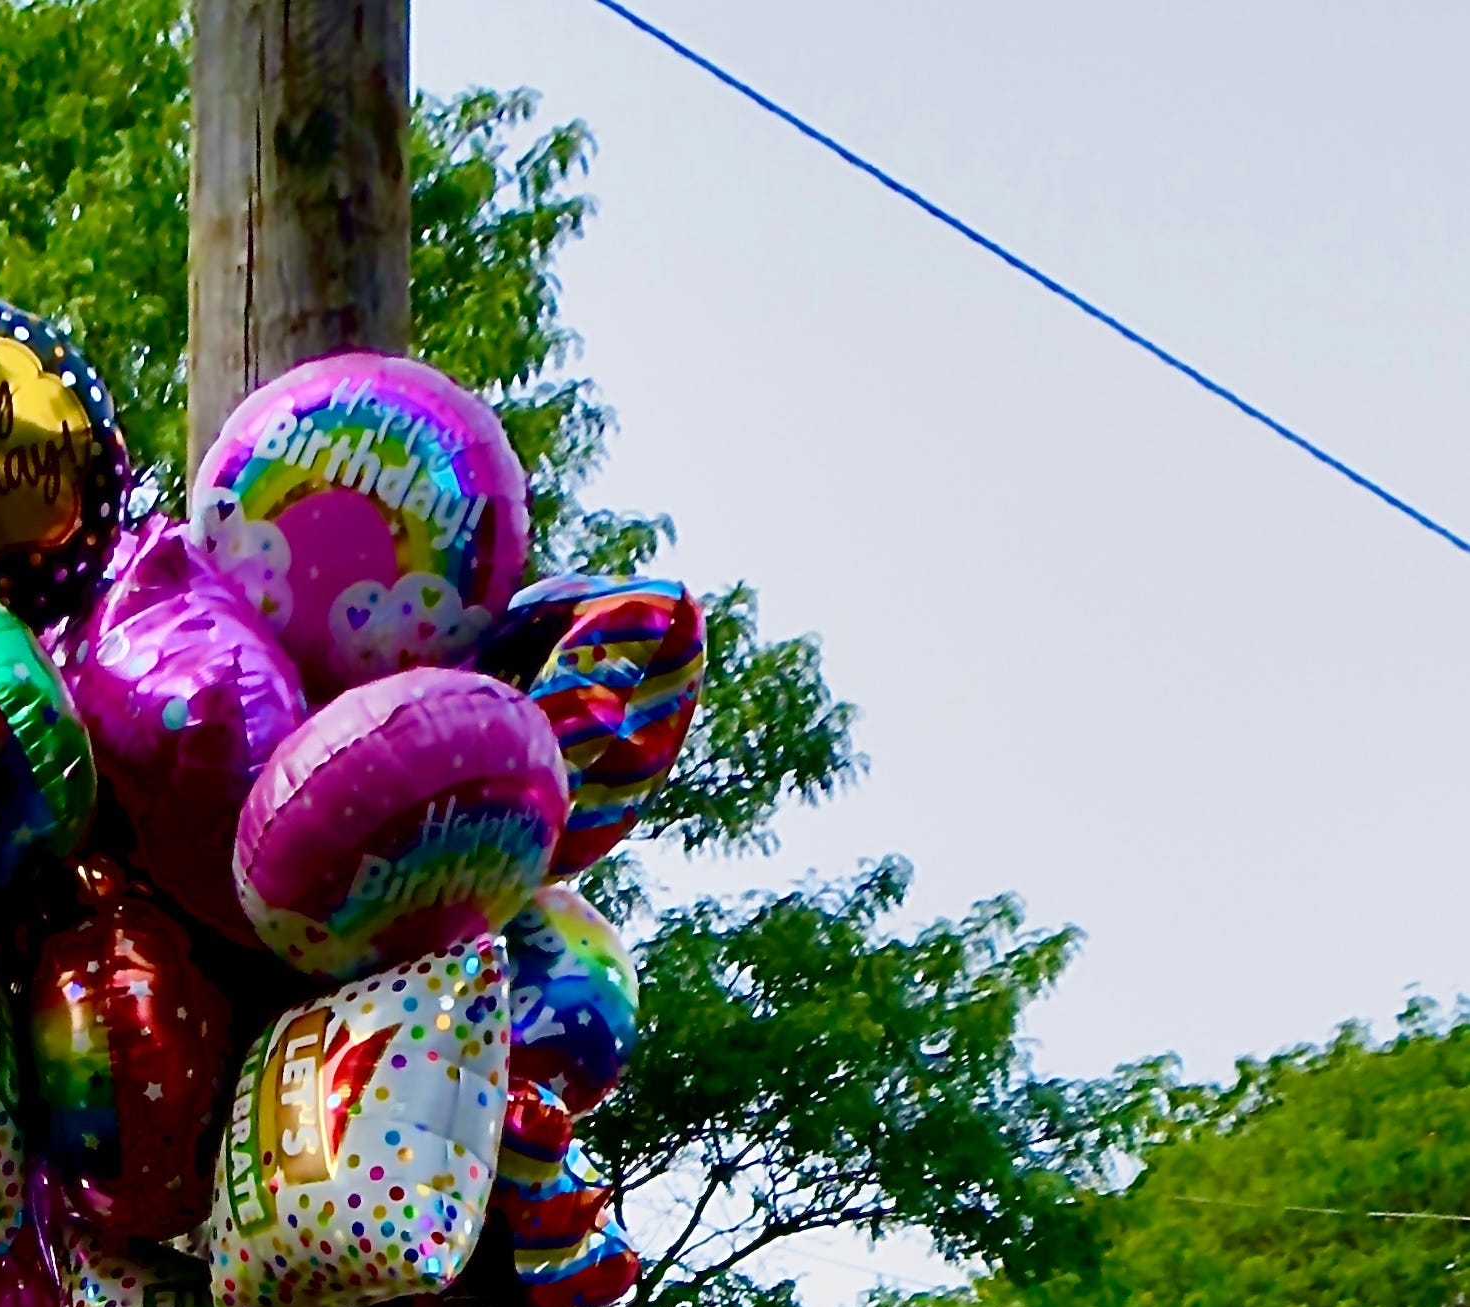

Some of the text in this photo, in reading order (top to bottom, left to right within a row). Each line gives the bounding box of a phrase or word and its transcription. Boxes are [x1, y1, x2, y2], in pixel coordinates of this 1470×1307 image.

[252, 409, 489, 550] Birthday!
[326, 376, 464, 470] Happy
[281, 1032, 320, 1158] LET'S
